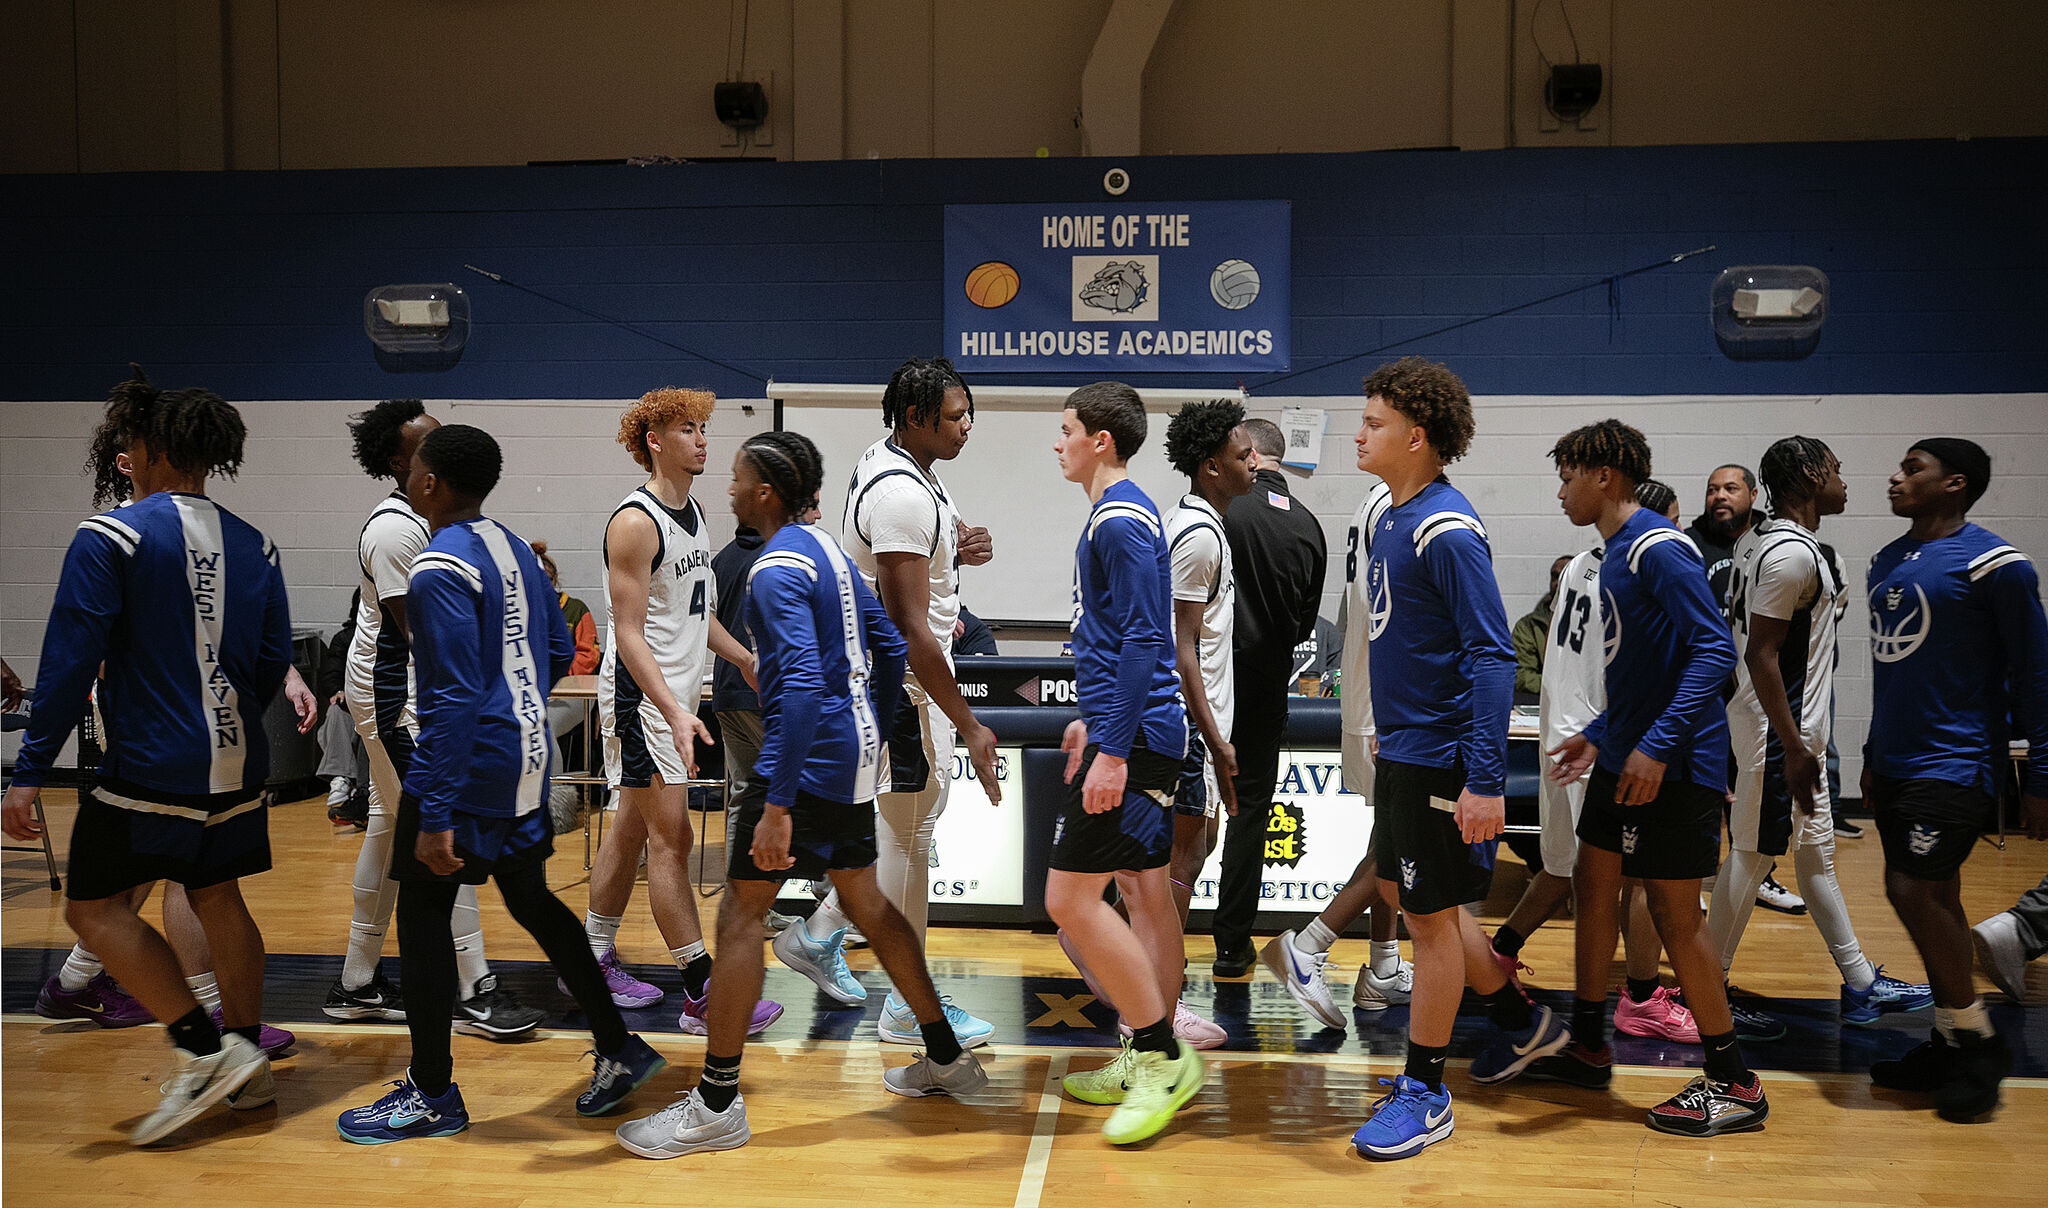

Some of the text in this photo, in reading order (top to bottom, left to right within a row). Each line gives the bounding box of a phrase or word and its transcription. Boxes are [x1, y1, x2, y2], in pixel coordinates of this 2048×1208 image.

[1042, 214, 1190, 248] HOME OF THE
[961, 330, 1273, 356] HILLHOUSE ACADEMICS
[689, 579, 706, 621] 4
[1557, 587, 1592, 655] 13
